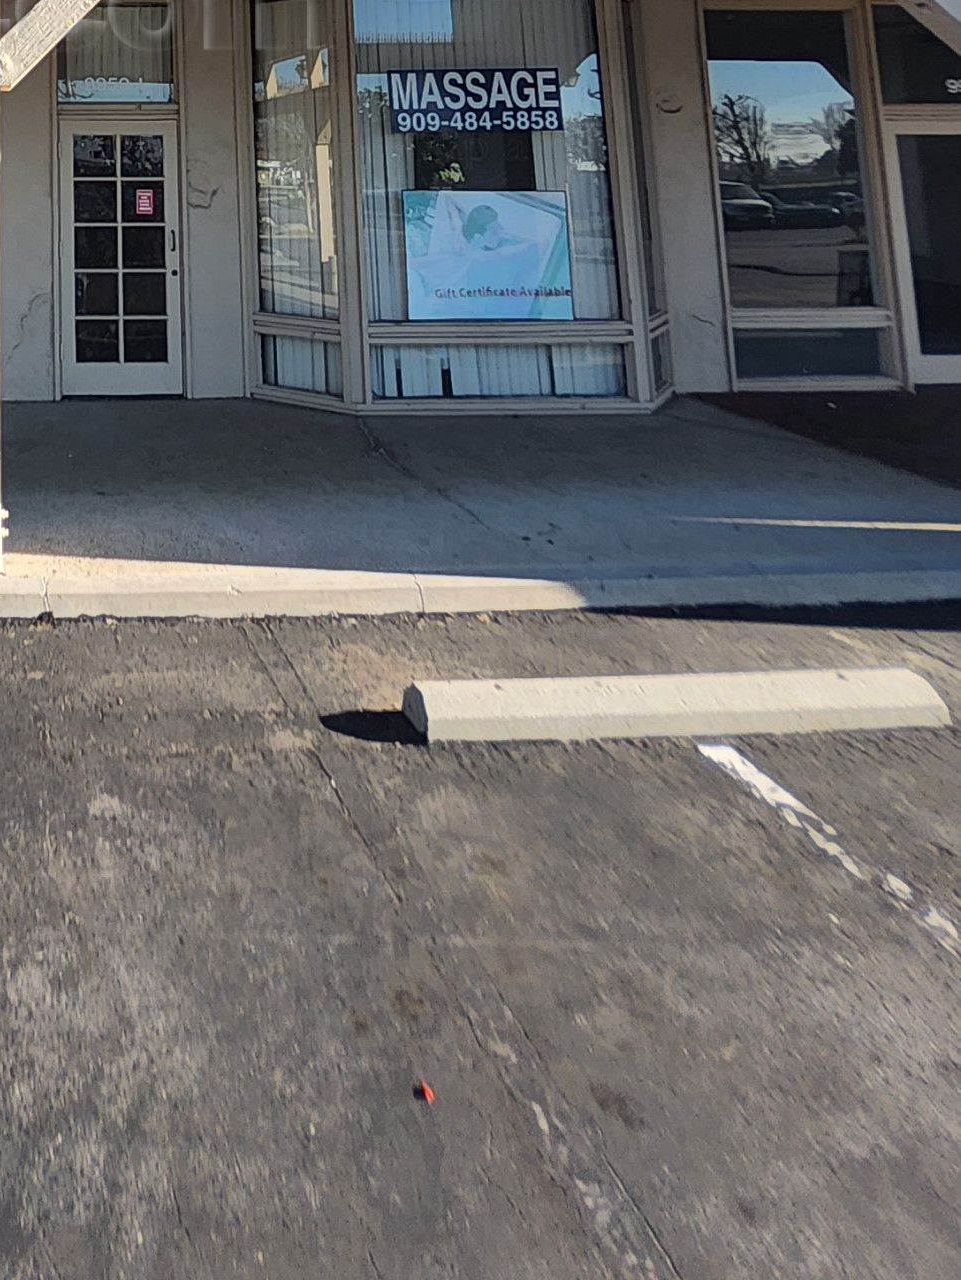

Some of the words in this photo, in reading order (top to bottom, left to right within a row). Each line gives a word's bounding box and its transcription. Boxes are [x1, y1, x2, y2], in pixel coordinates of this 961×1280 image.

[390, 70, 560, 110] MASSAGE
[397, 111, 559, 132] 909-484-5858
[434, 287, 457, 299] Gift
[458, 286, 516, 298] Certificate
[518, 285, 573, 298] Available
